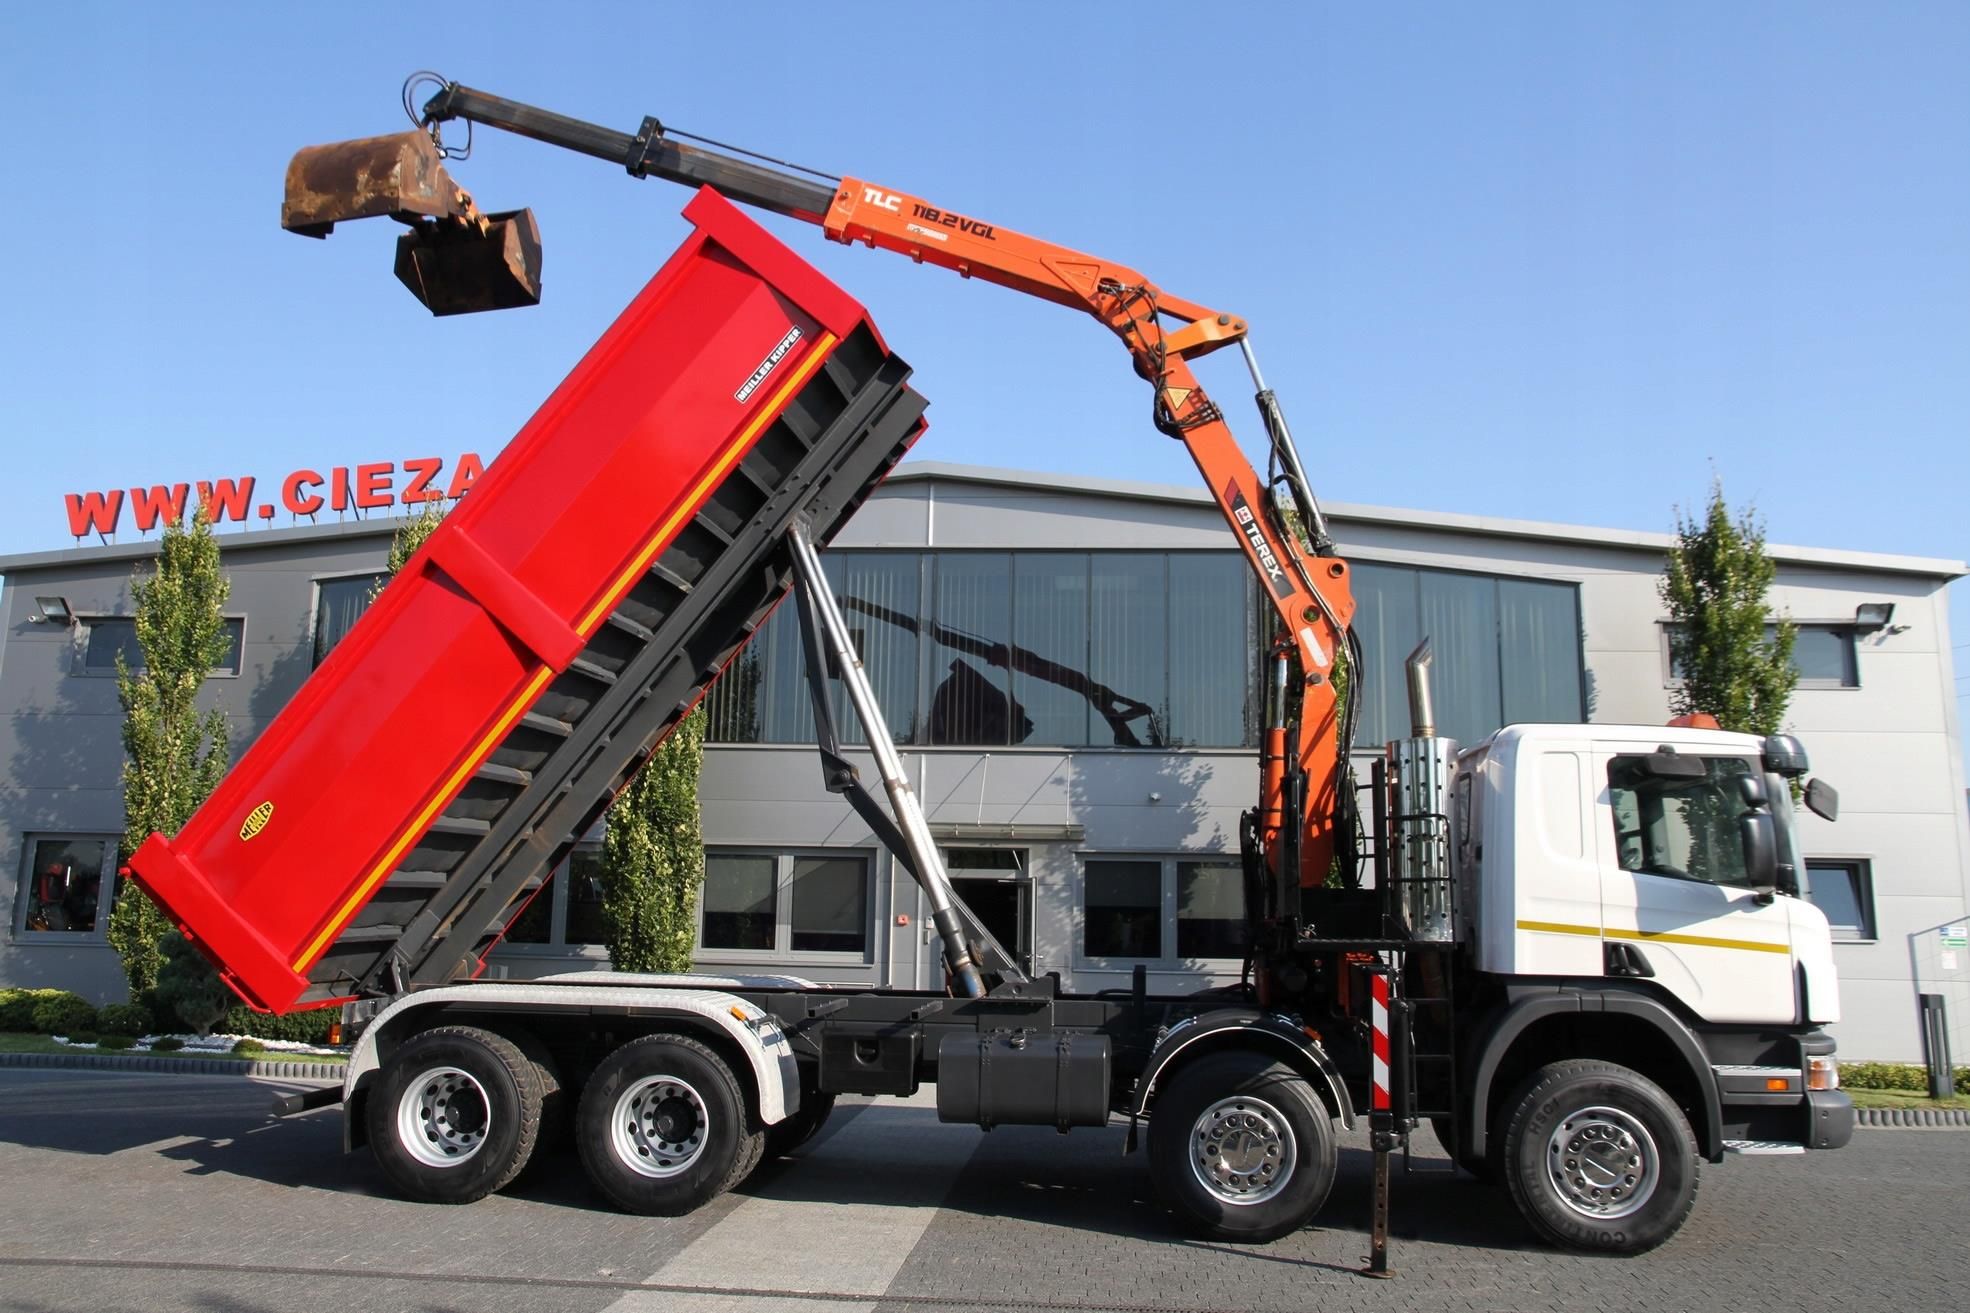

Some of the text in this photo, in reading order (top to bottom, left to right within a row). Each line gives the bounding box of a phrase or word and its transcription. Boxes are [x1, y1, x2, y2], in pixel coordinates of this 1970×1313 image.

[864, 187, 903, 212] TLC
[737, 328, 801, 401] MEILLER KIPPER
[1246, 522, 1283, 579] TEREX
